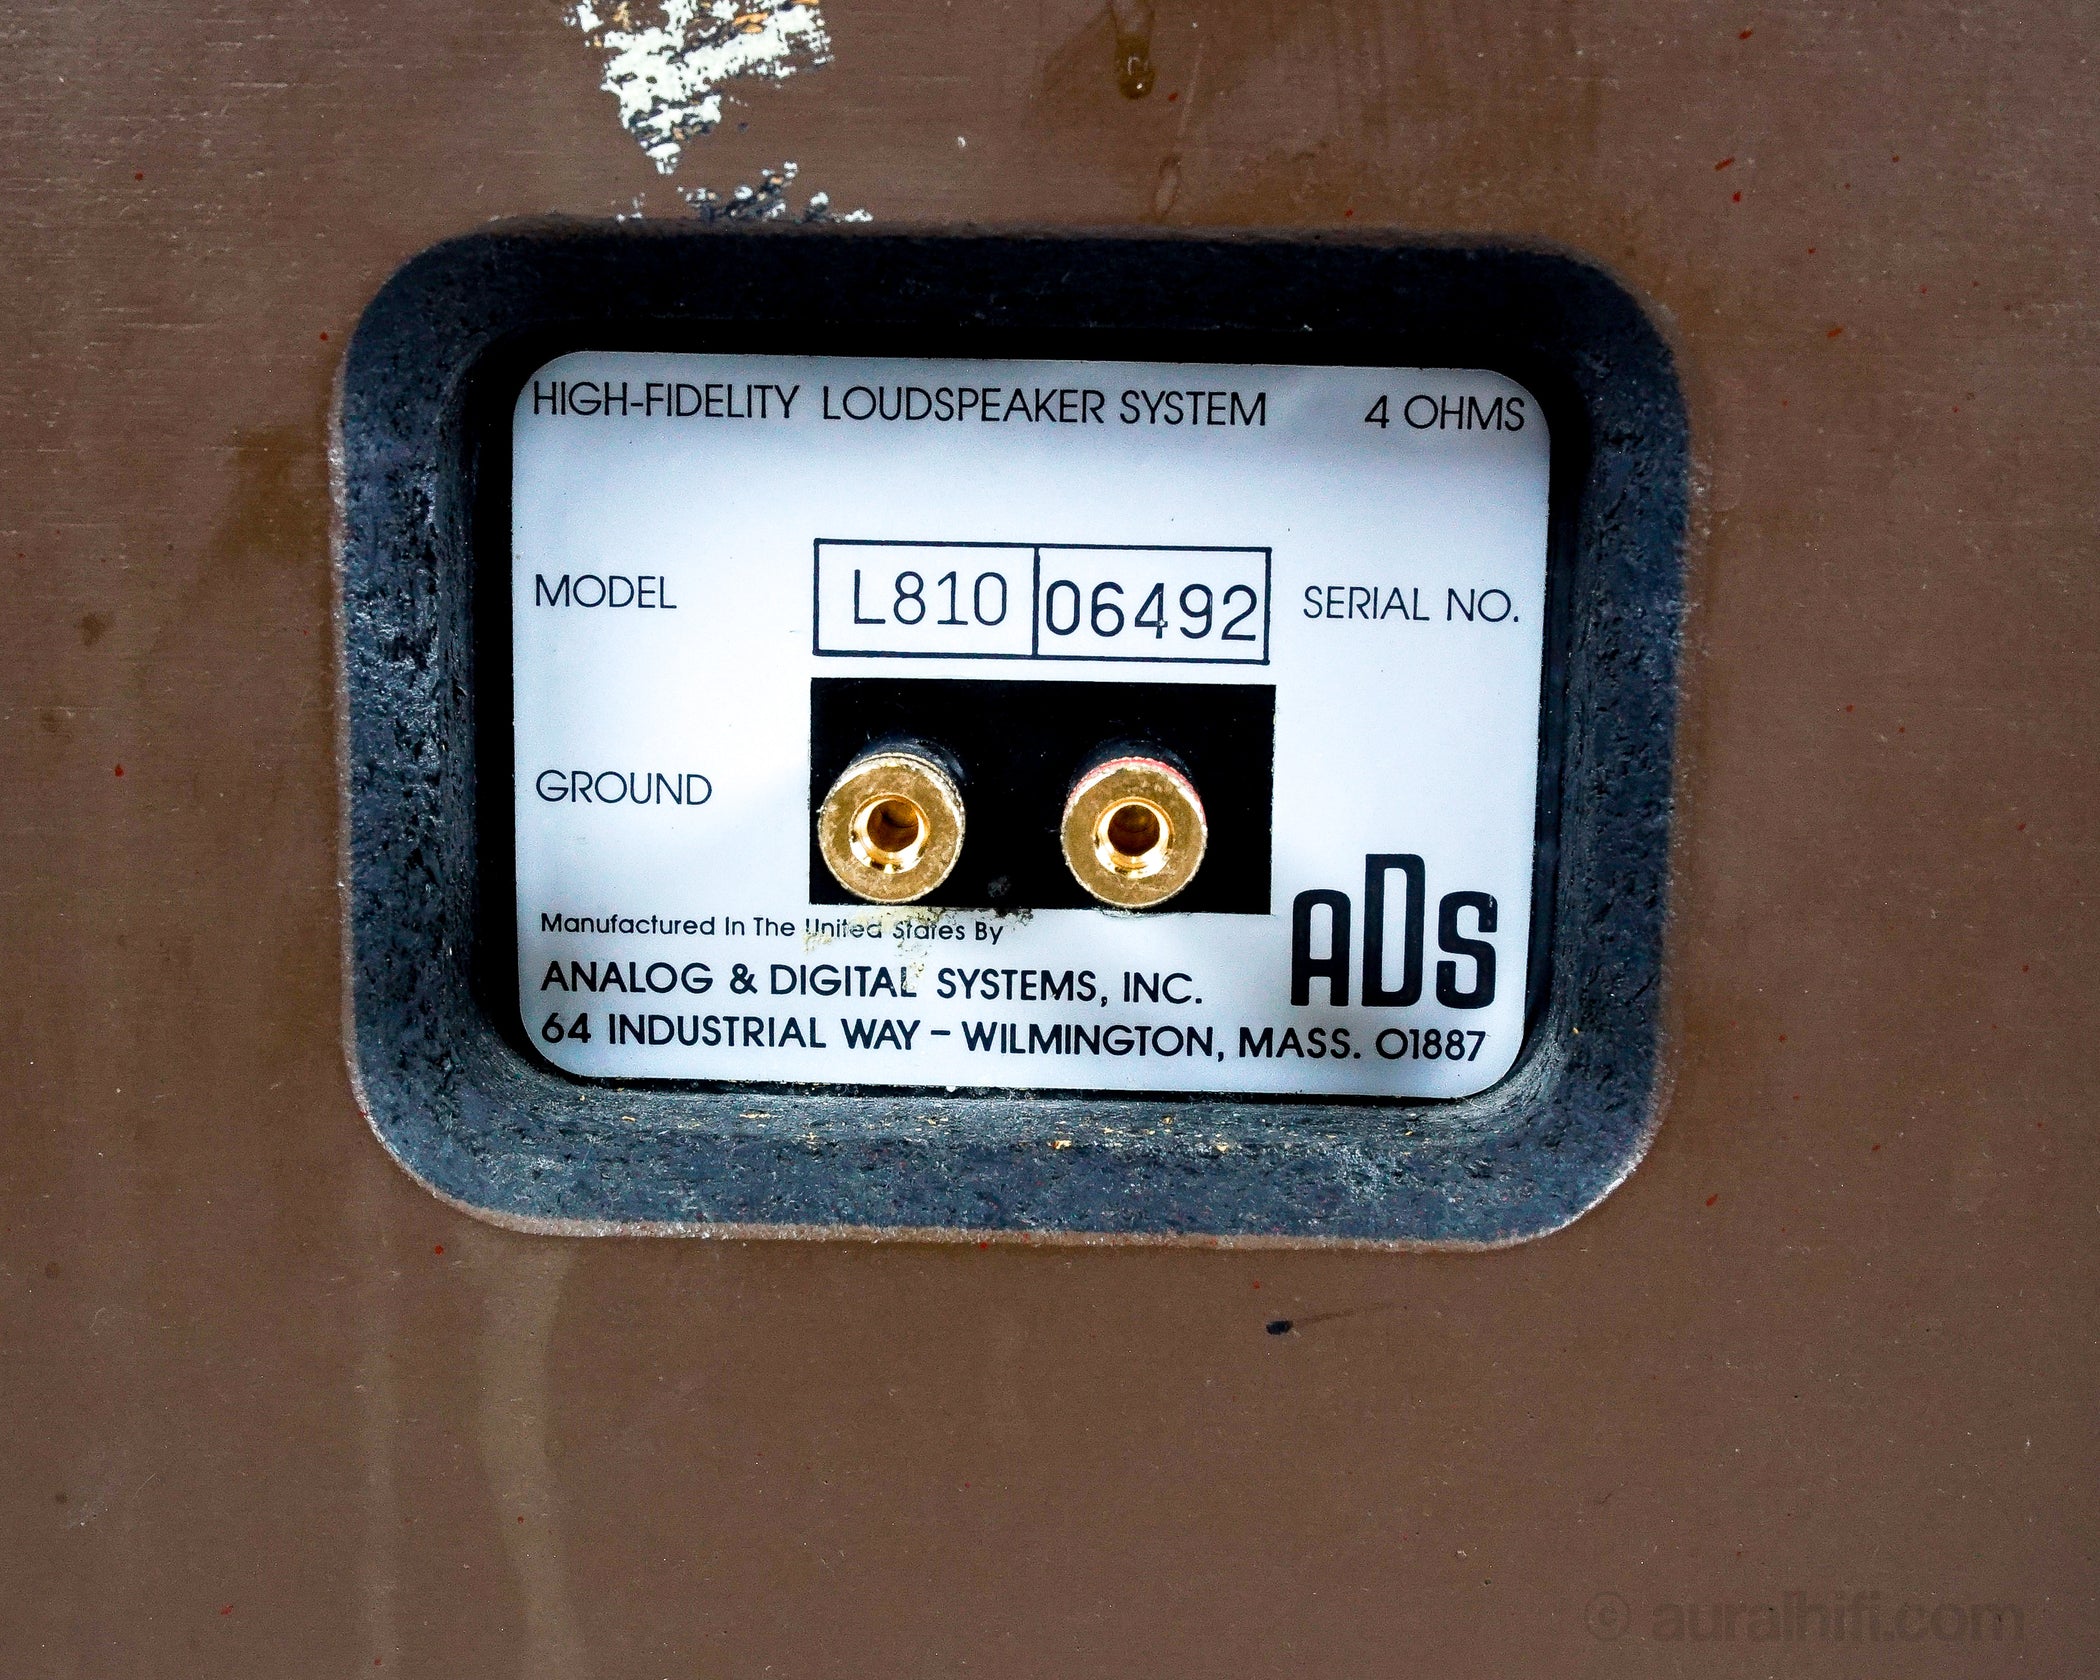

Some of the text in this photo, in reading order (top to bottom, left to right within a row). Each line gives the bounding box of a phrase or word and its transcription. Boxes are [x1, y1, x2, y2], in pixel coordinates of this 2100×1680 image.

[533, 380, 1267, 427] HIGH-FIDELITY LOUDSPEAKER SYSTEM
[1364, 393, 1525, 431] 4 OHMS
[535, 573, 677, 609] MODEL
[853, 569, 1007, 626] L810
[1046, 579, 1258, 642] 06492
[1303, 585, 1519, 623] SERIAL NO.
[535, 769, 713, 806] GROUND
[540, 912, 1004, 946] Manufactured In The United States By
[540, 960, 1203, 1008] ANALOG & DIGITAL SYSTEMS, INC.
[540, 1012, 592, 1044] 64
[608, 1013, 827, 1049] INDUSTRIAL
[840, 1018, 921, 1051] WAY
[961, 1020, 1225, 1063] WILMINGTON,
[1238, 1025, 1362, 1060] MASS.
